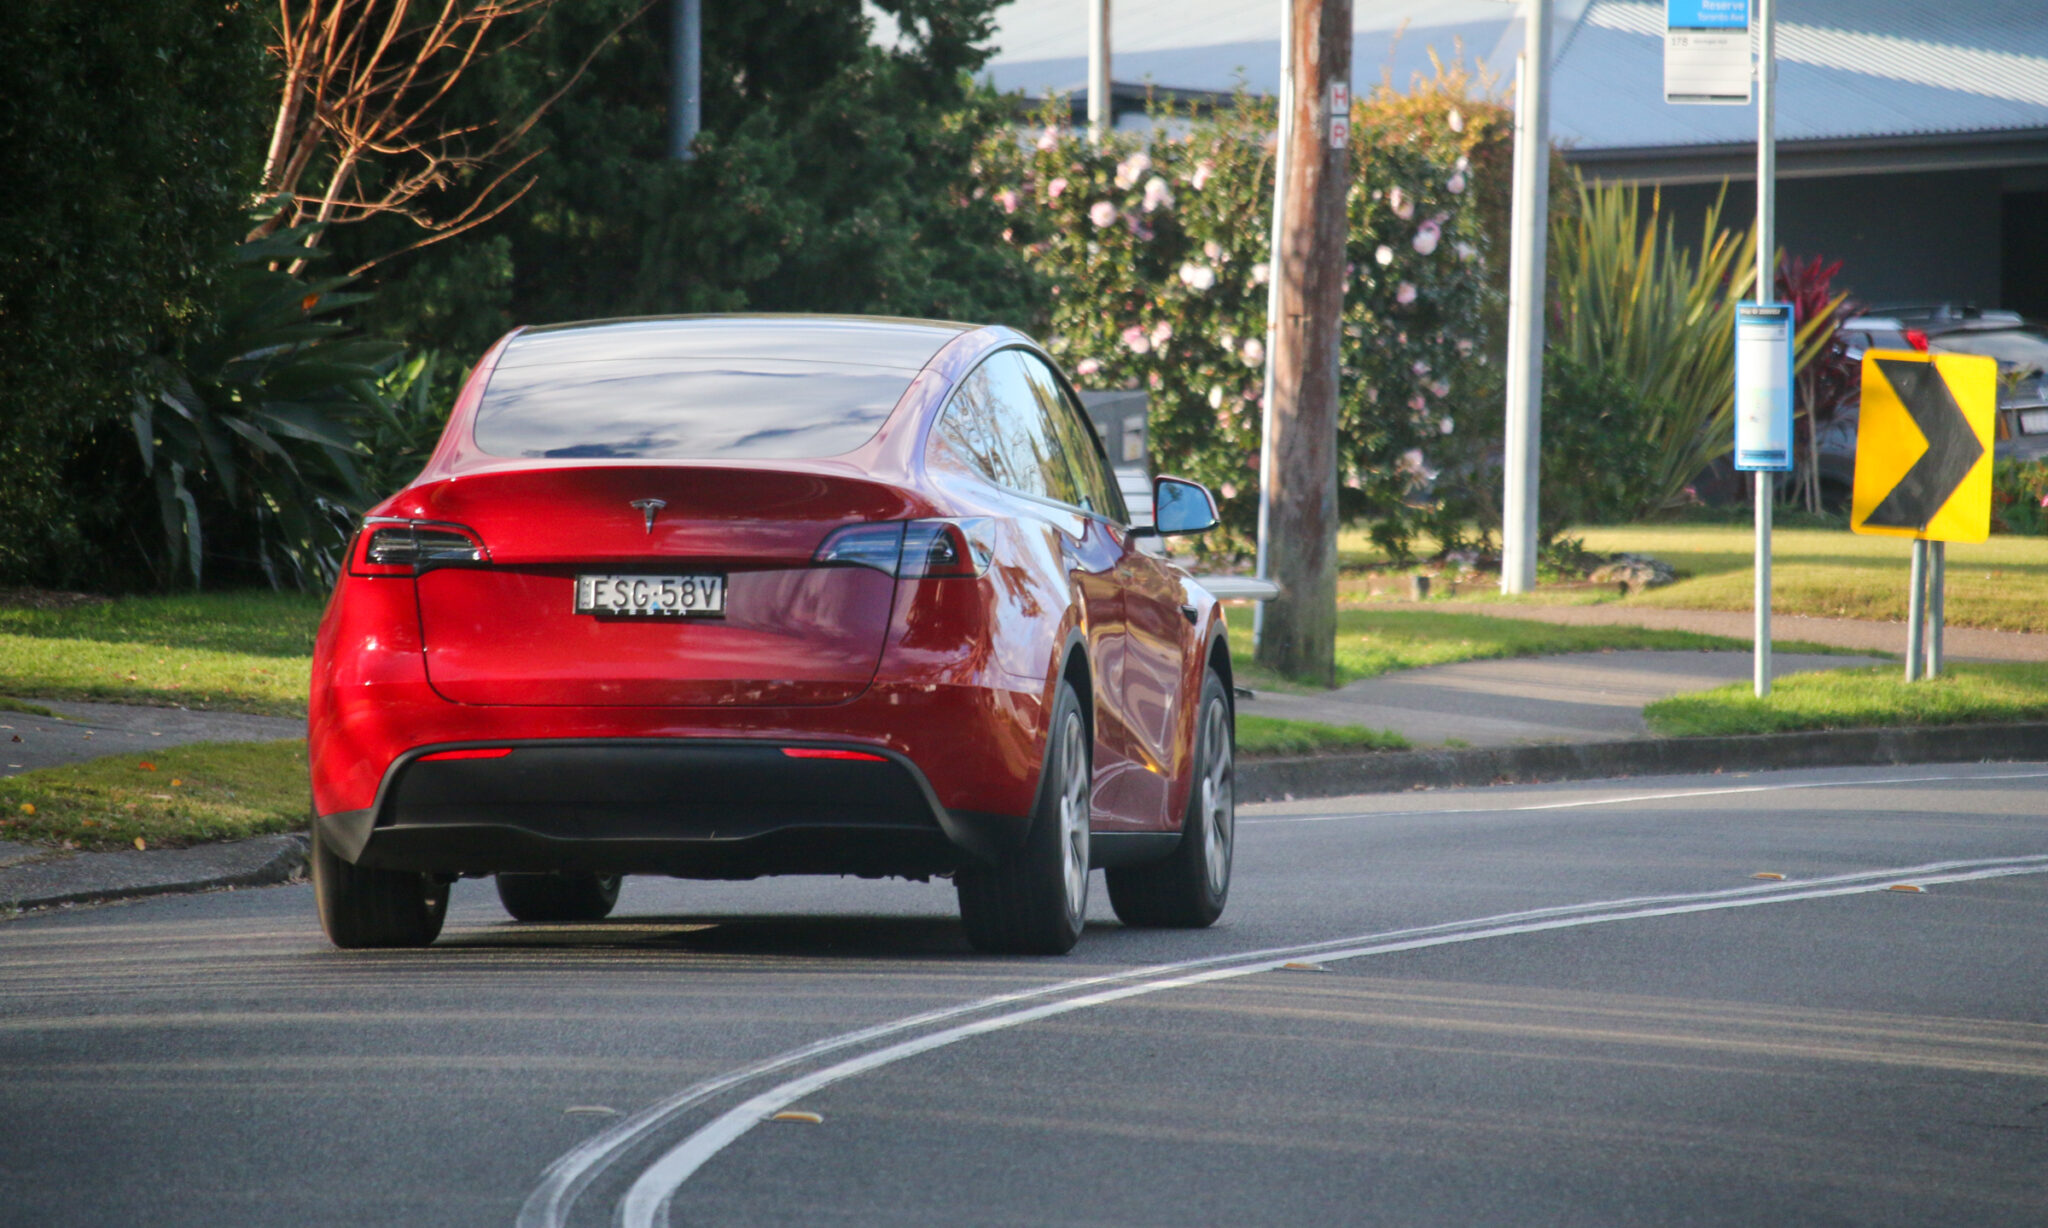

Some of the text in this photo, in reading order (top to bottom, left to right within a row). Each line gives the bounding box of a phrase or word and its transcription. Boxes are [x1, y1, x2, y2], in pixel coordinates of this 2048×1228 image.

[1701, 0, 1745, 10] Reserve
[1333, 87, 1347, 107] H
[1332, 123, 1347, 146] R
